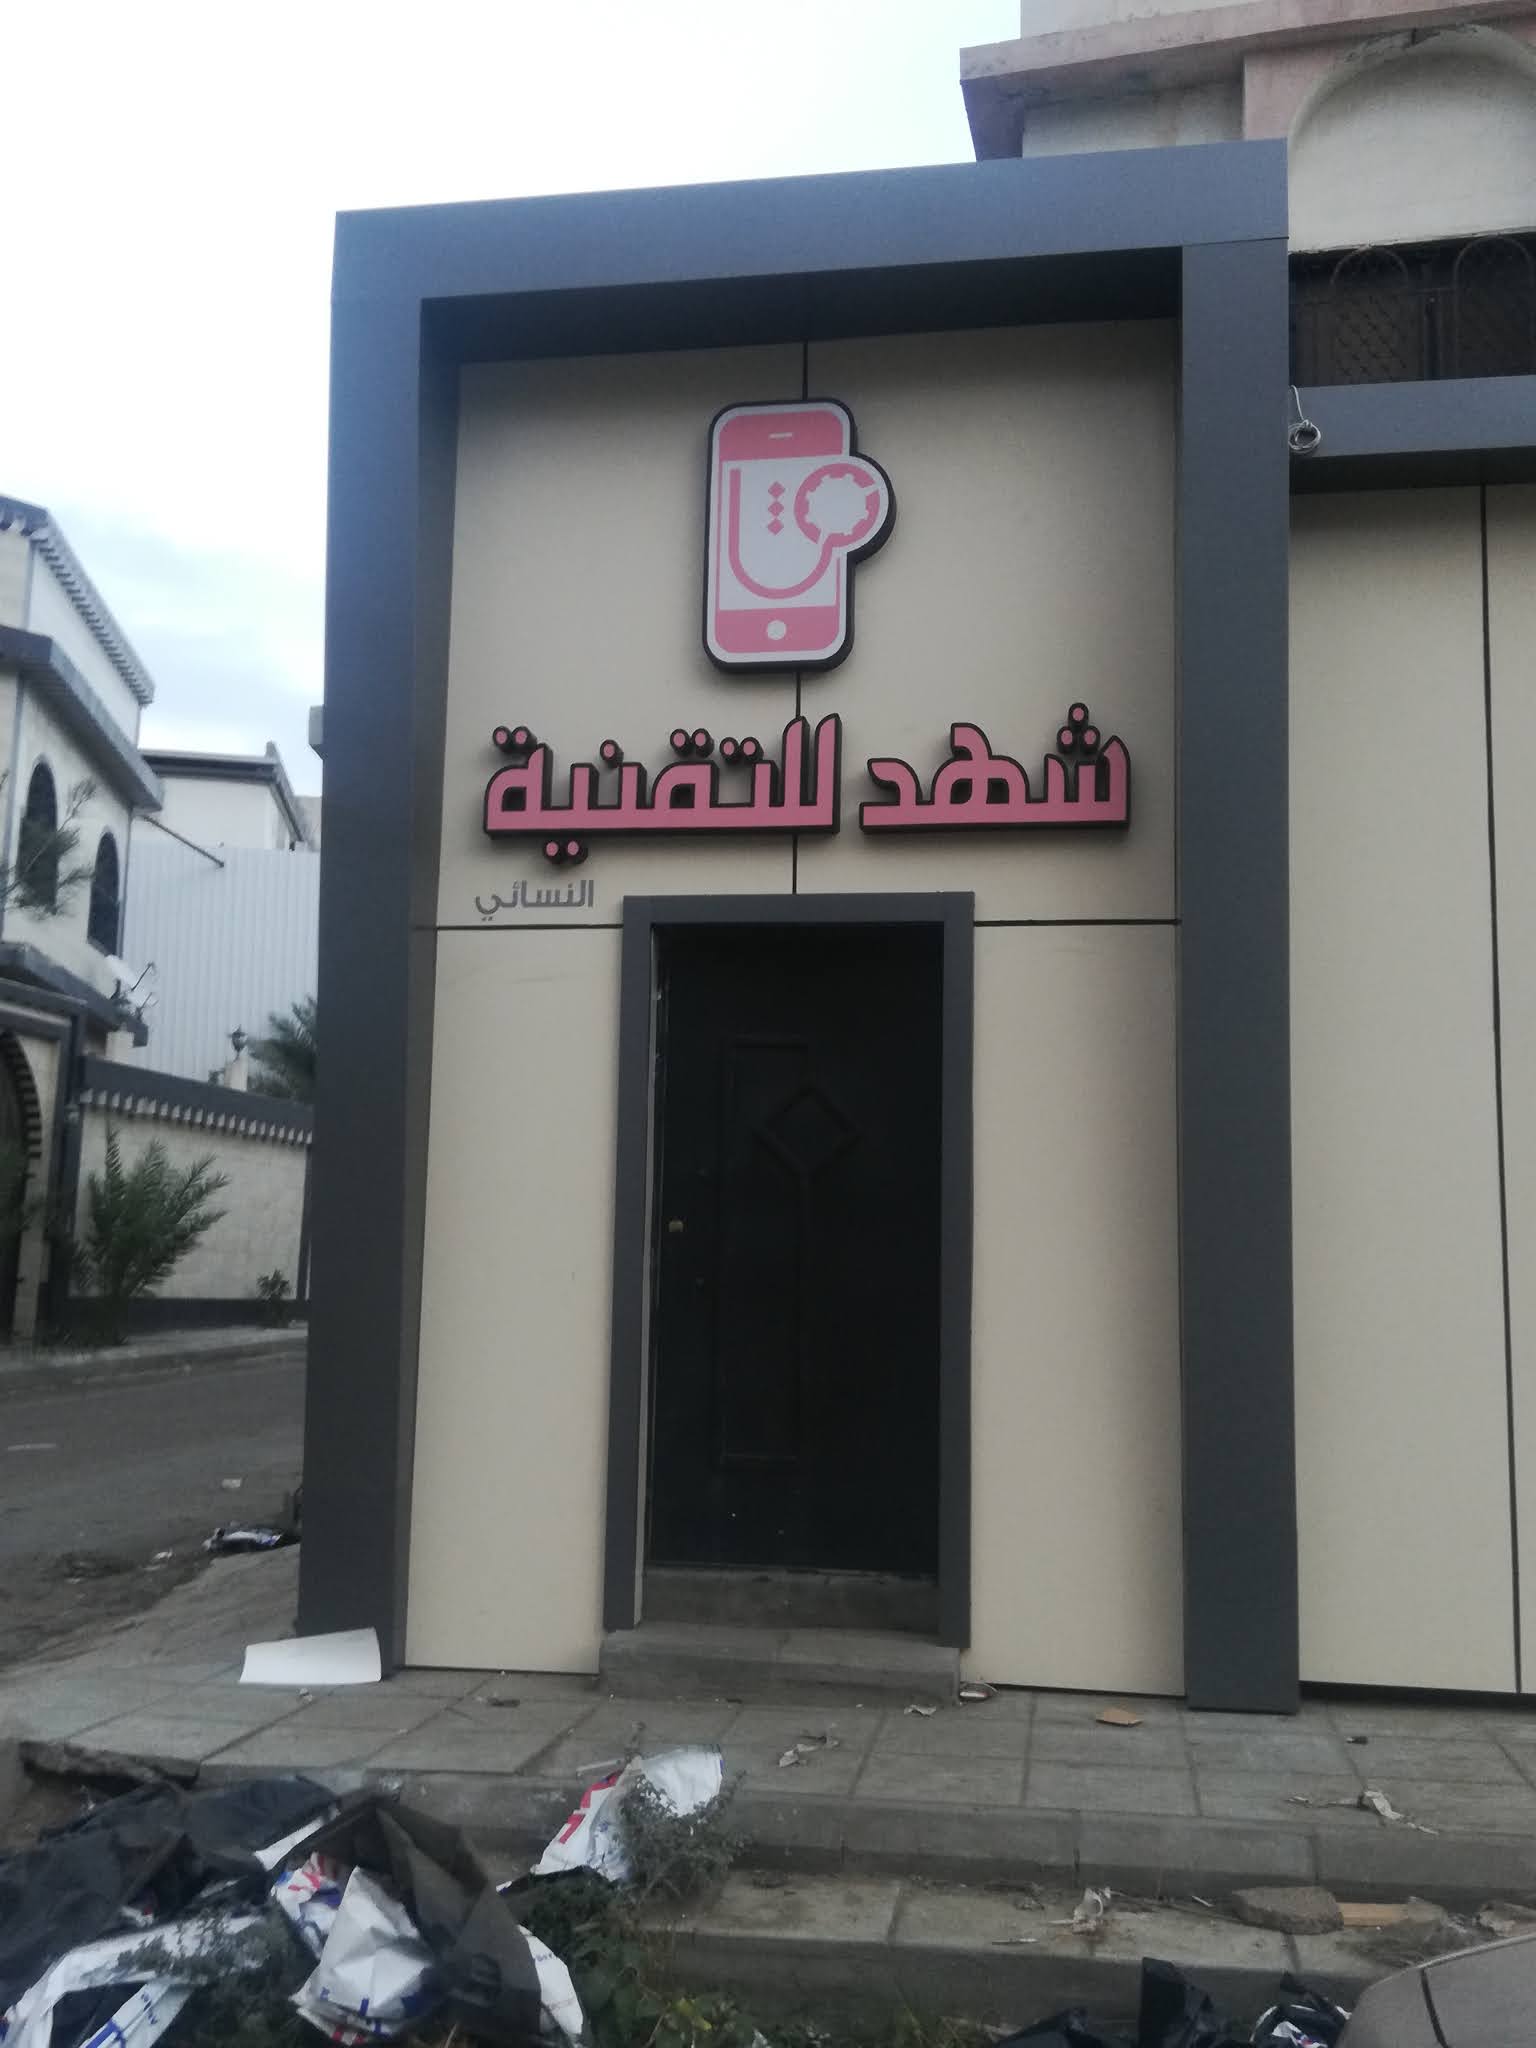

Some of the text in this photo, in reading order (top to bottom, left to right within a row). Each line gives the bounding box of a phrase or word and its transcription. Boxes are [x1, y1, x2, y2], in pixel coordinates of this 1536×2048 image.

[484, 702, 1132, 864] شهد للتقنية
[475, 879, 594, 922] النسائي
